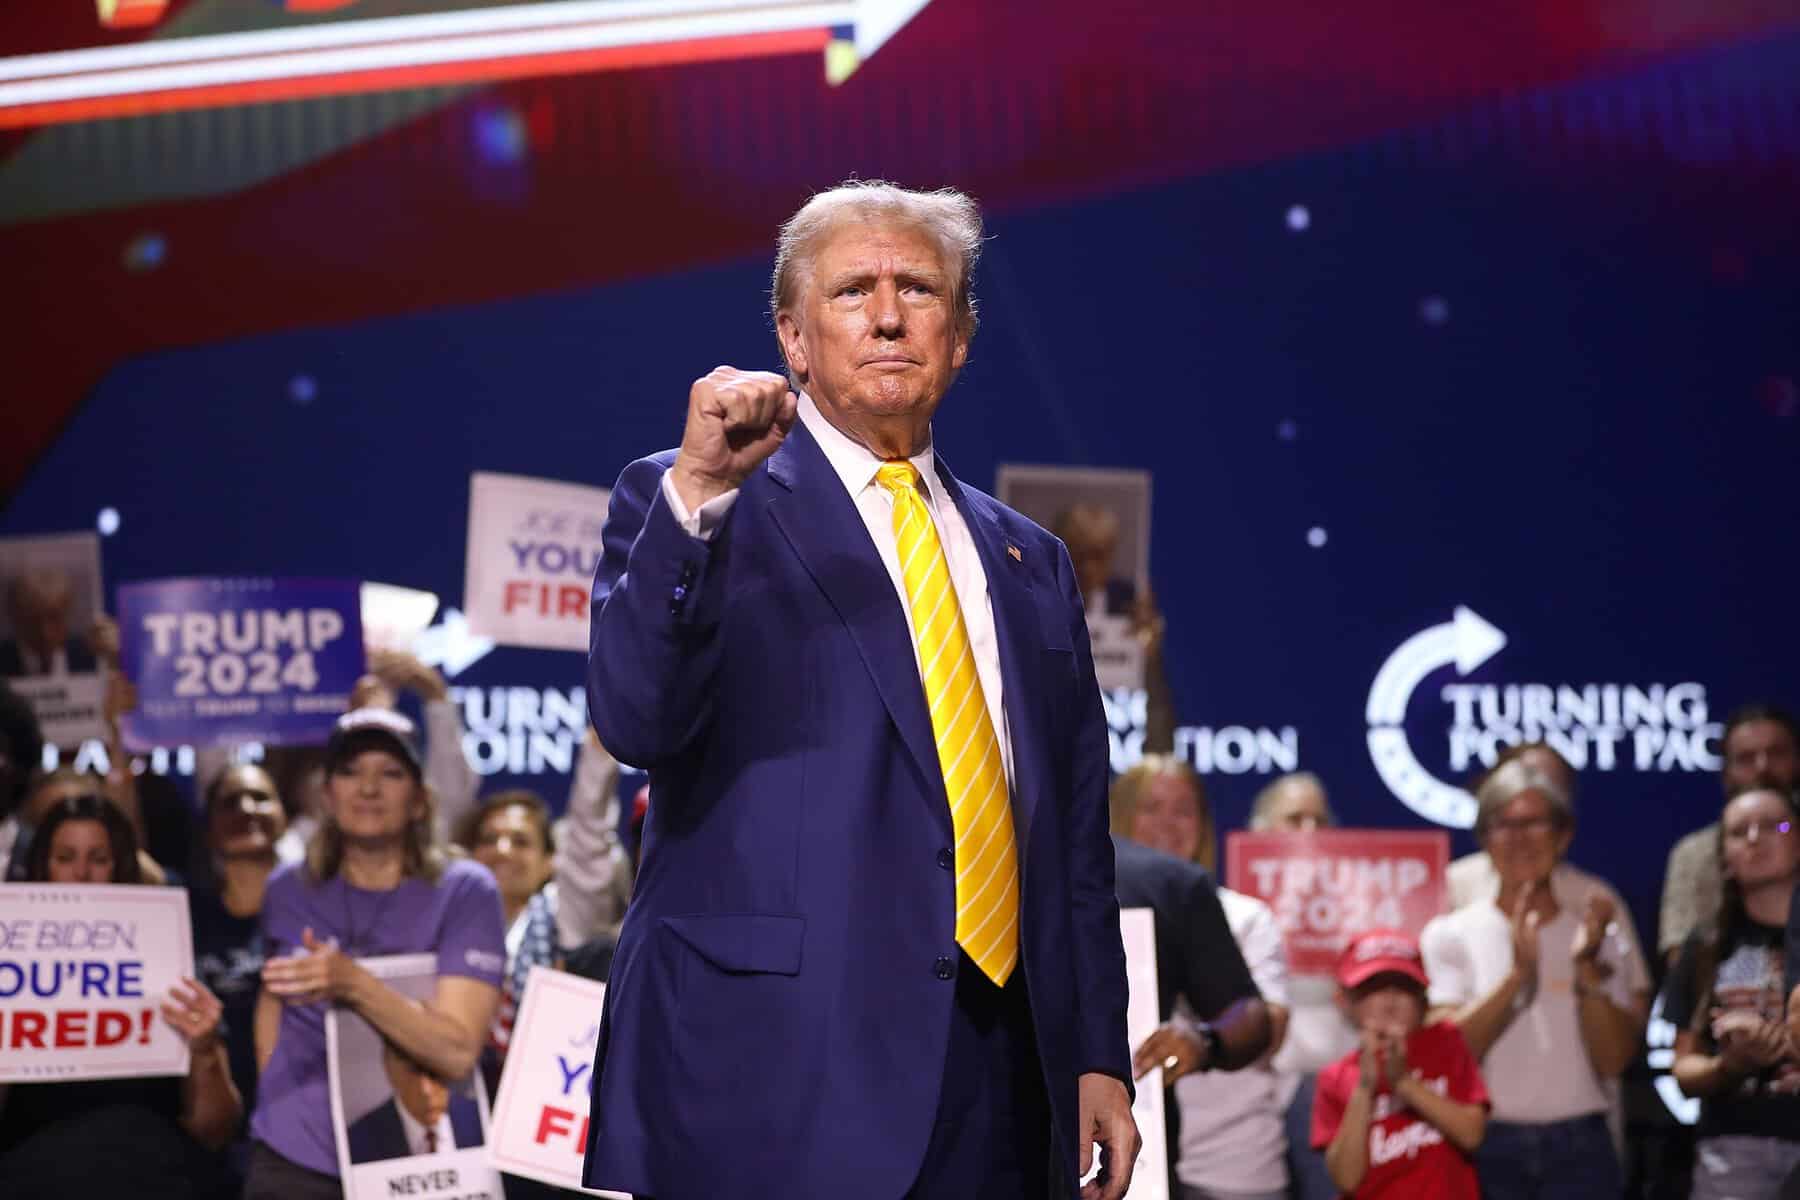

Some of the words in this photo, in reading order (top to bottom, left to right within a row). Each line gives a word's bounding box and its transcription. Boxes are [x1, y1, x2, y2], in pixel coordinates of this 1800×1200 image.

[143, 608, 343, 657] TRUMP
[173, 650, 319, 696] 2024
[449, 686, 587, 736] URN
[1441, 683, 1708, 731] TURNING
[461, 729, 585, 776] OIN
[1633, 722, 1723, 771] PAC
[1250, 857, 1429, 899] TRUMP
[36, 919, 138, 950] BIDEN
[387, 1168, 462, 1197] NEVER
